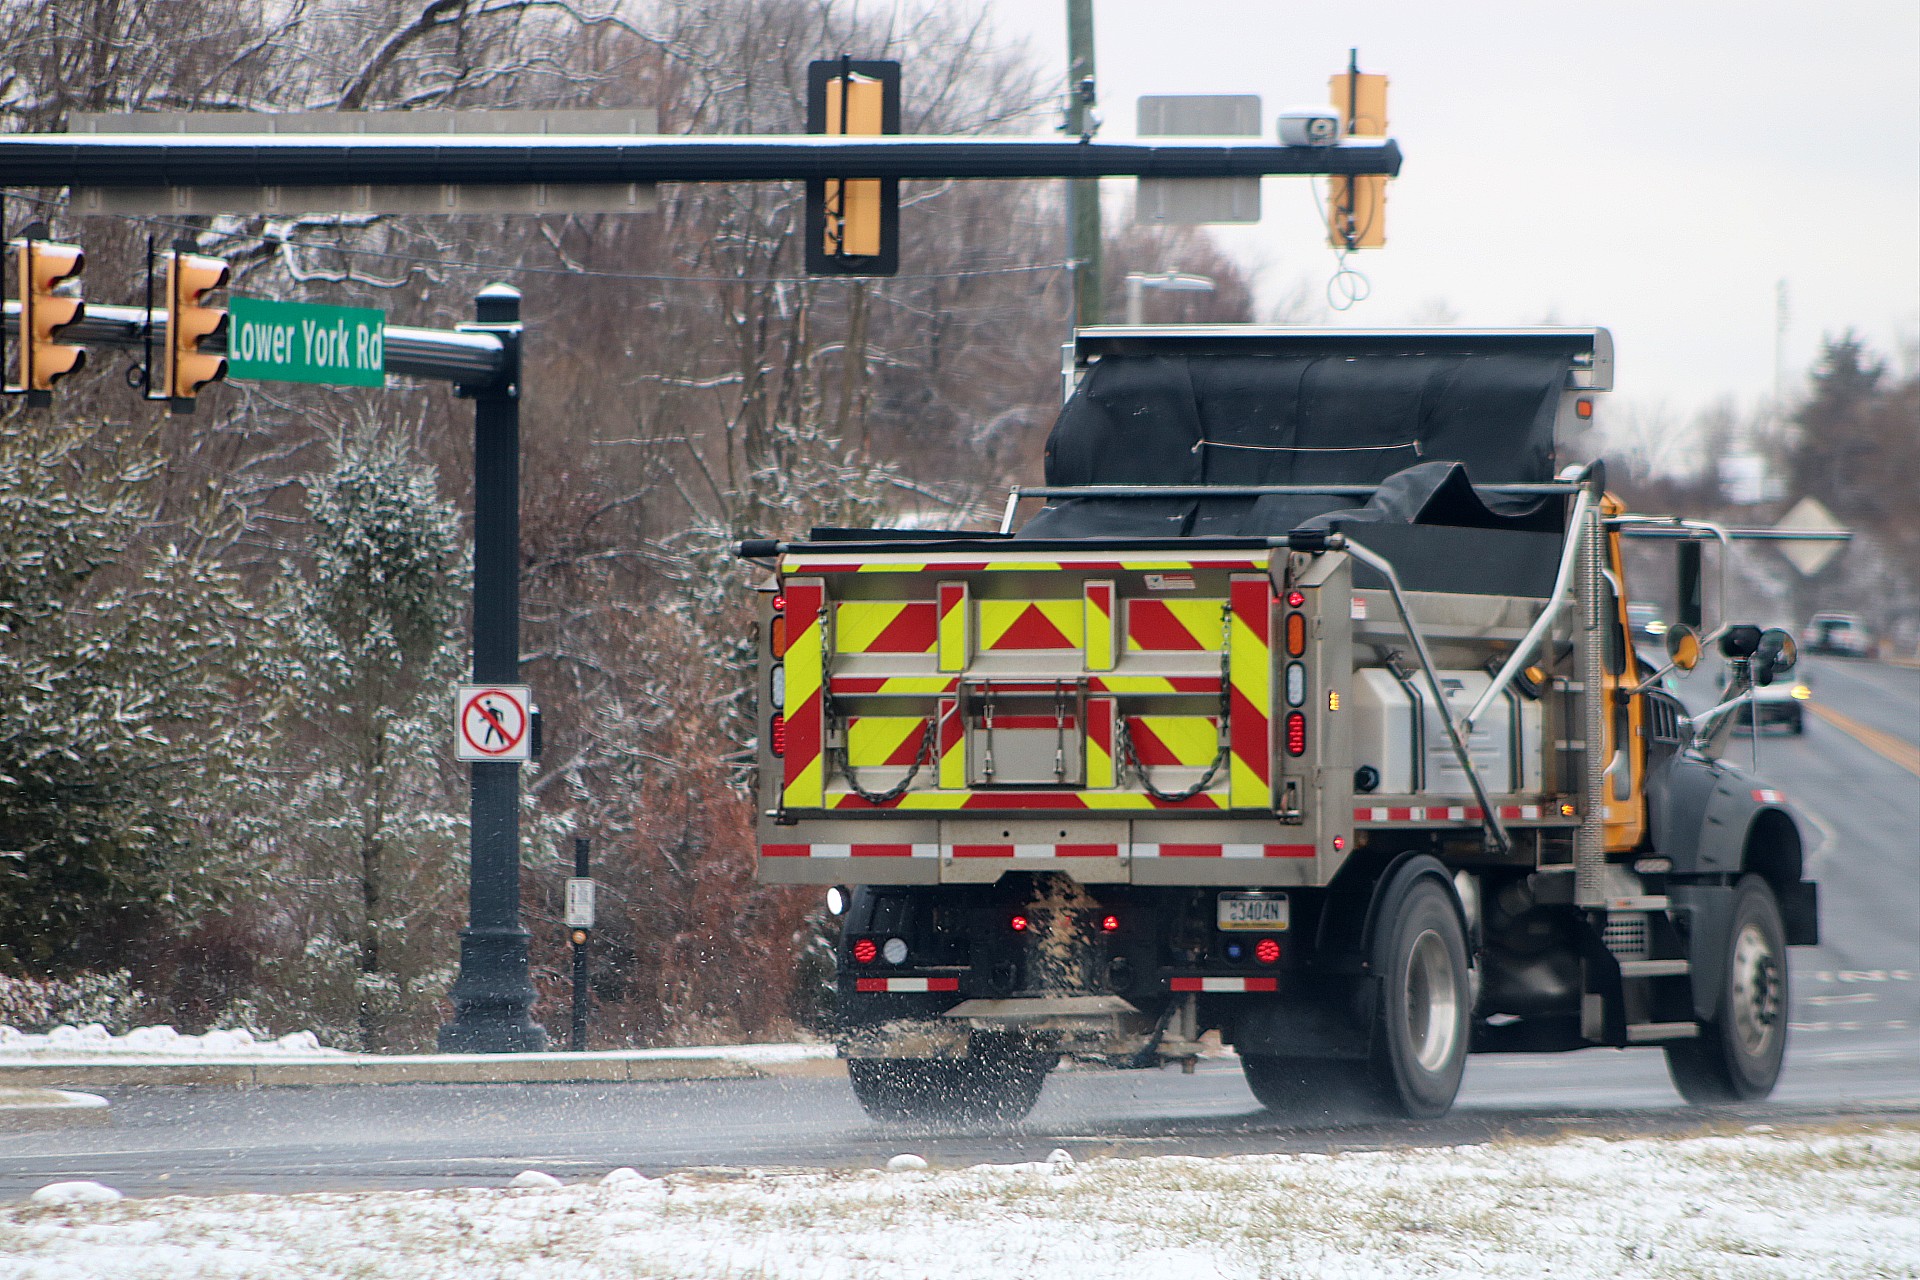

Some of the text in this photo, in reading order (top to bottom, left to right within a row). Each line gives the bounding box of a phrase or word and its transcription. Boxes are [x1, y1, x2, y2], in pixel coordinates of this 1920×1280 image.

[230, 314, 382, 370] Lower York Rd
